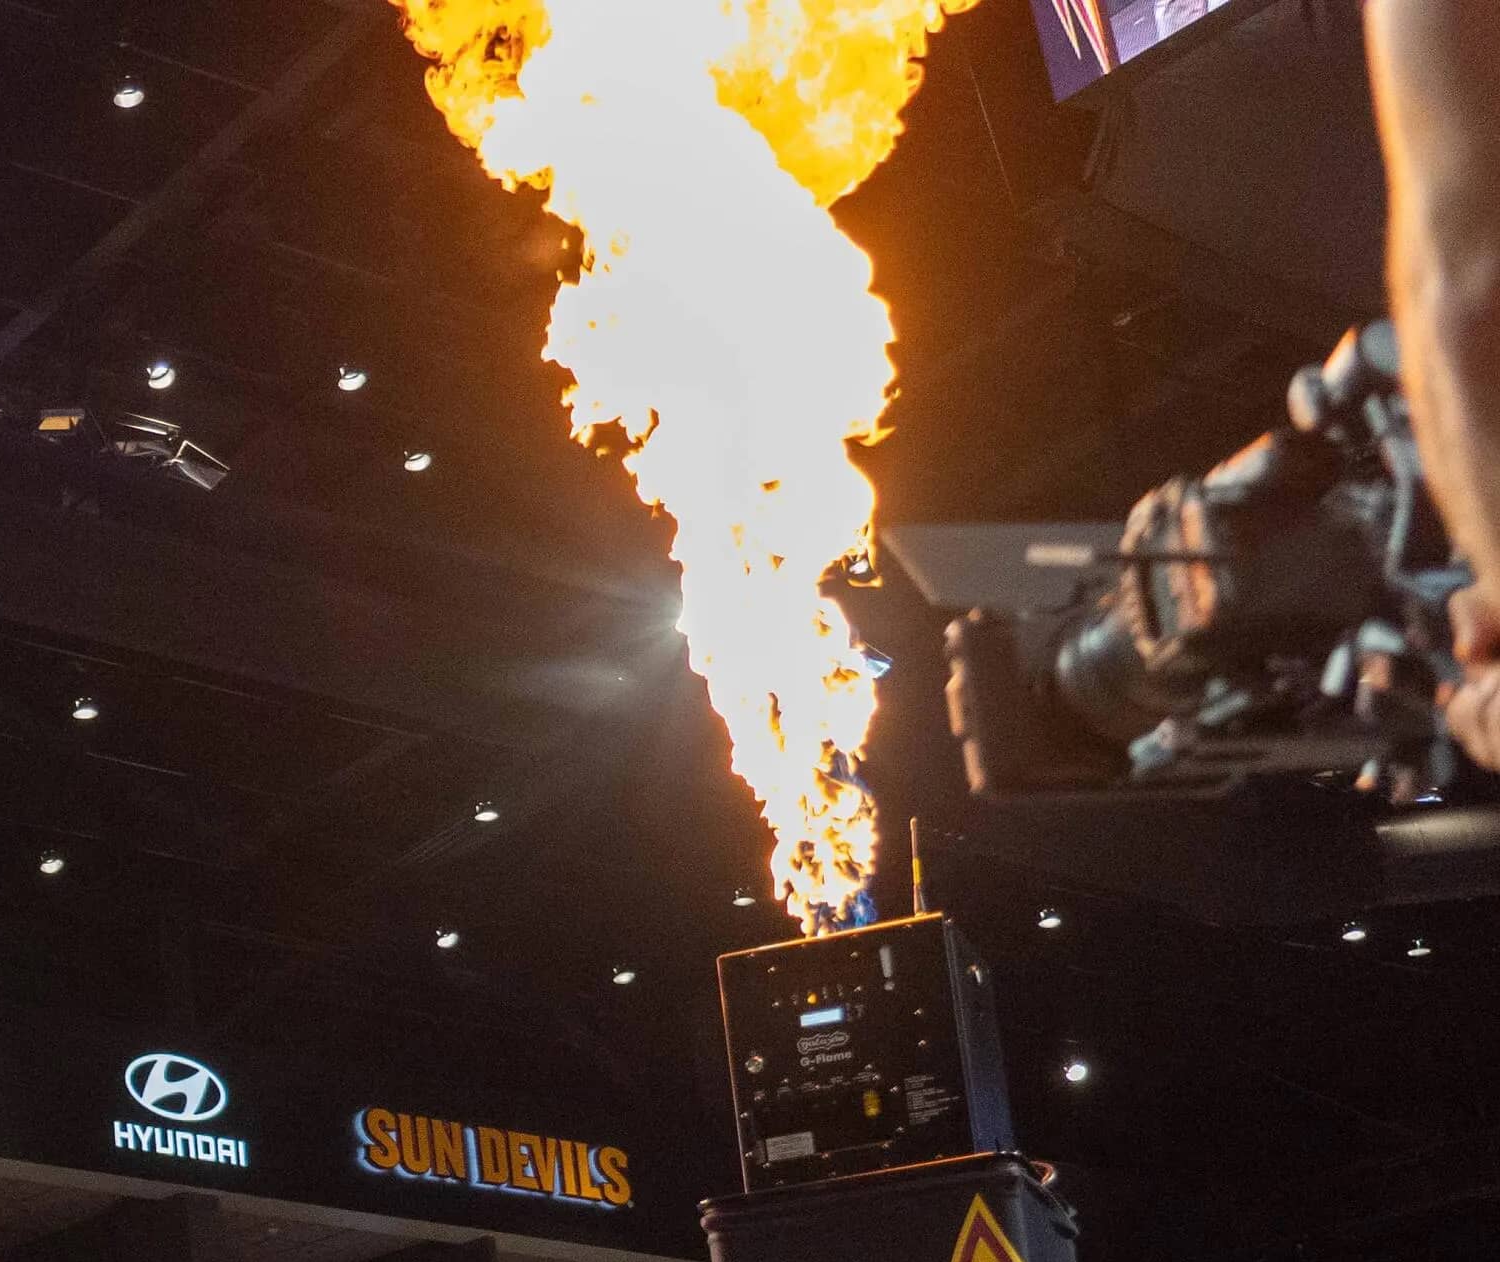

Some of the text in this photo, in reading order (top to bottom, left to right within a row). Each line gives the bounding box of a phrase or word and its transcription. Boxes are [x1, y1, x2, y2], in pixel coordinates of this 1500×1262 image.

[113, 1120, 249, 1167] HYUNDAI
[357, 1107, 632, 1207] SUN DEVILS
